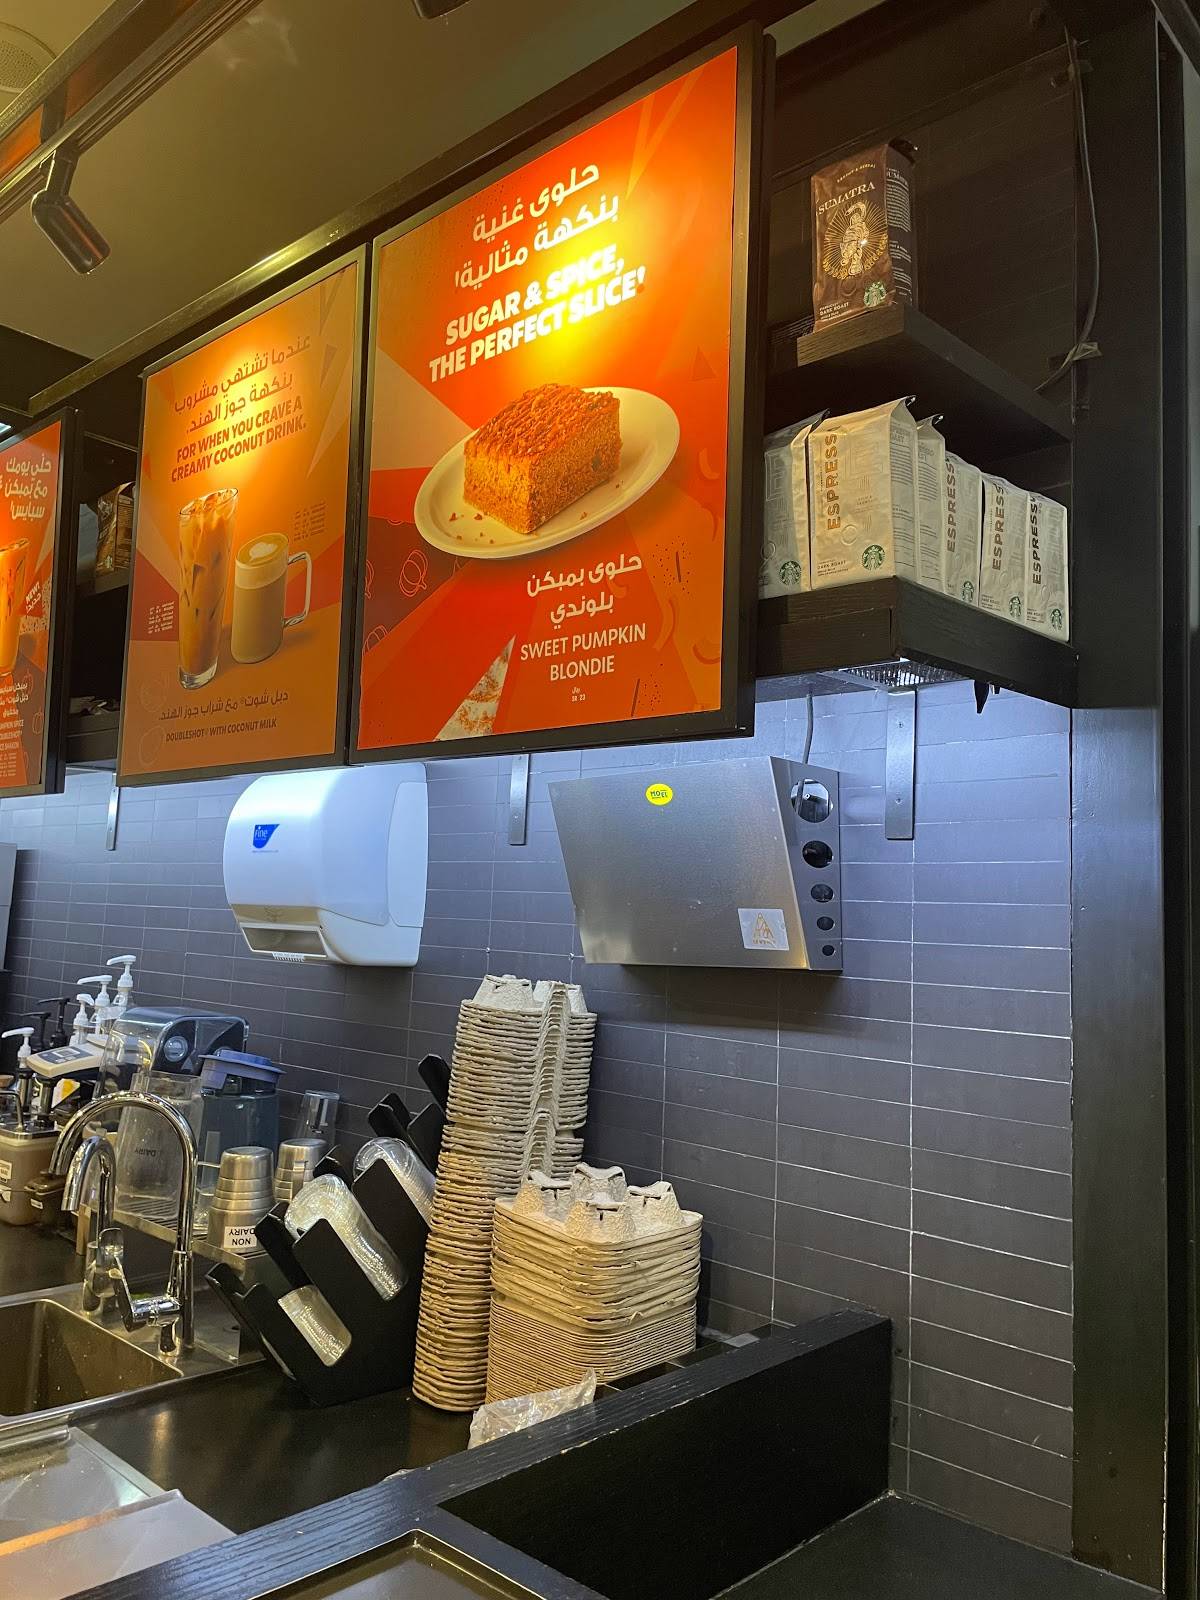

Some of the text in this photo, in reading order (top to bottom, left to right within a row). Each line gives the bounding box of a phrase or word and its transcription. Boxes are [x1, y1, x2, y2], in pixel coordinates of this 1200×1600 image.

[472, 163, 600, 244] حلوى غنية
[818, 181, 876, 216] SUMATRA
[454, 193, 620, 291] بنكهة مثالية!
[445, 244, 625, 346] SUGAR & SPICE,
[428, 266, 647, 383] THE PERFECT SLICE!
[174, 335, 311, 415] عندما تشتهي مشروب
[249, 371, 293, 402] بنكهة
[177, 395, 303, 463] FOR WHEN YOU CRAVE A
[223, 397, 246, 420] جوز
[6, 457, 31, 476] يومك
[171, 414, 307, 483] CREAMY COCONUT DRINK.
[825, 432, 841, 531] ESPRESS
[945, 457, 956, 553] ESPRESS
[992, 482, 1005, 571] ESPRESS
[1030, 496, 1041, 585] ESPRESS
[527, 553, 642, 597] حلوى بمبكن
[550, 591, 614, 630] بلوندي
[520, 623, 646, 661] SWEET PUMPKIN
[550, 655, 615, 681] BLONDIE
[225, 698, 238, 713] مع
[270, 688, 289, 706] دبل
[209, 724, 227, 738] WITH
[227, 720, 259, 734] COCONUT
[259, 716, 277, 730] MILK
[228, 1227, 256, 1236] DAIRY
[231, 1237, 251, 1246] NON
